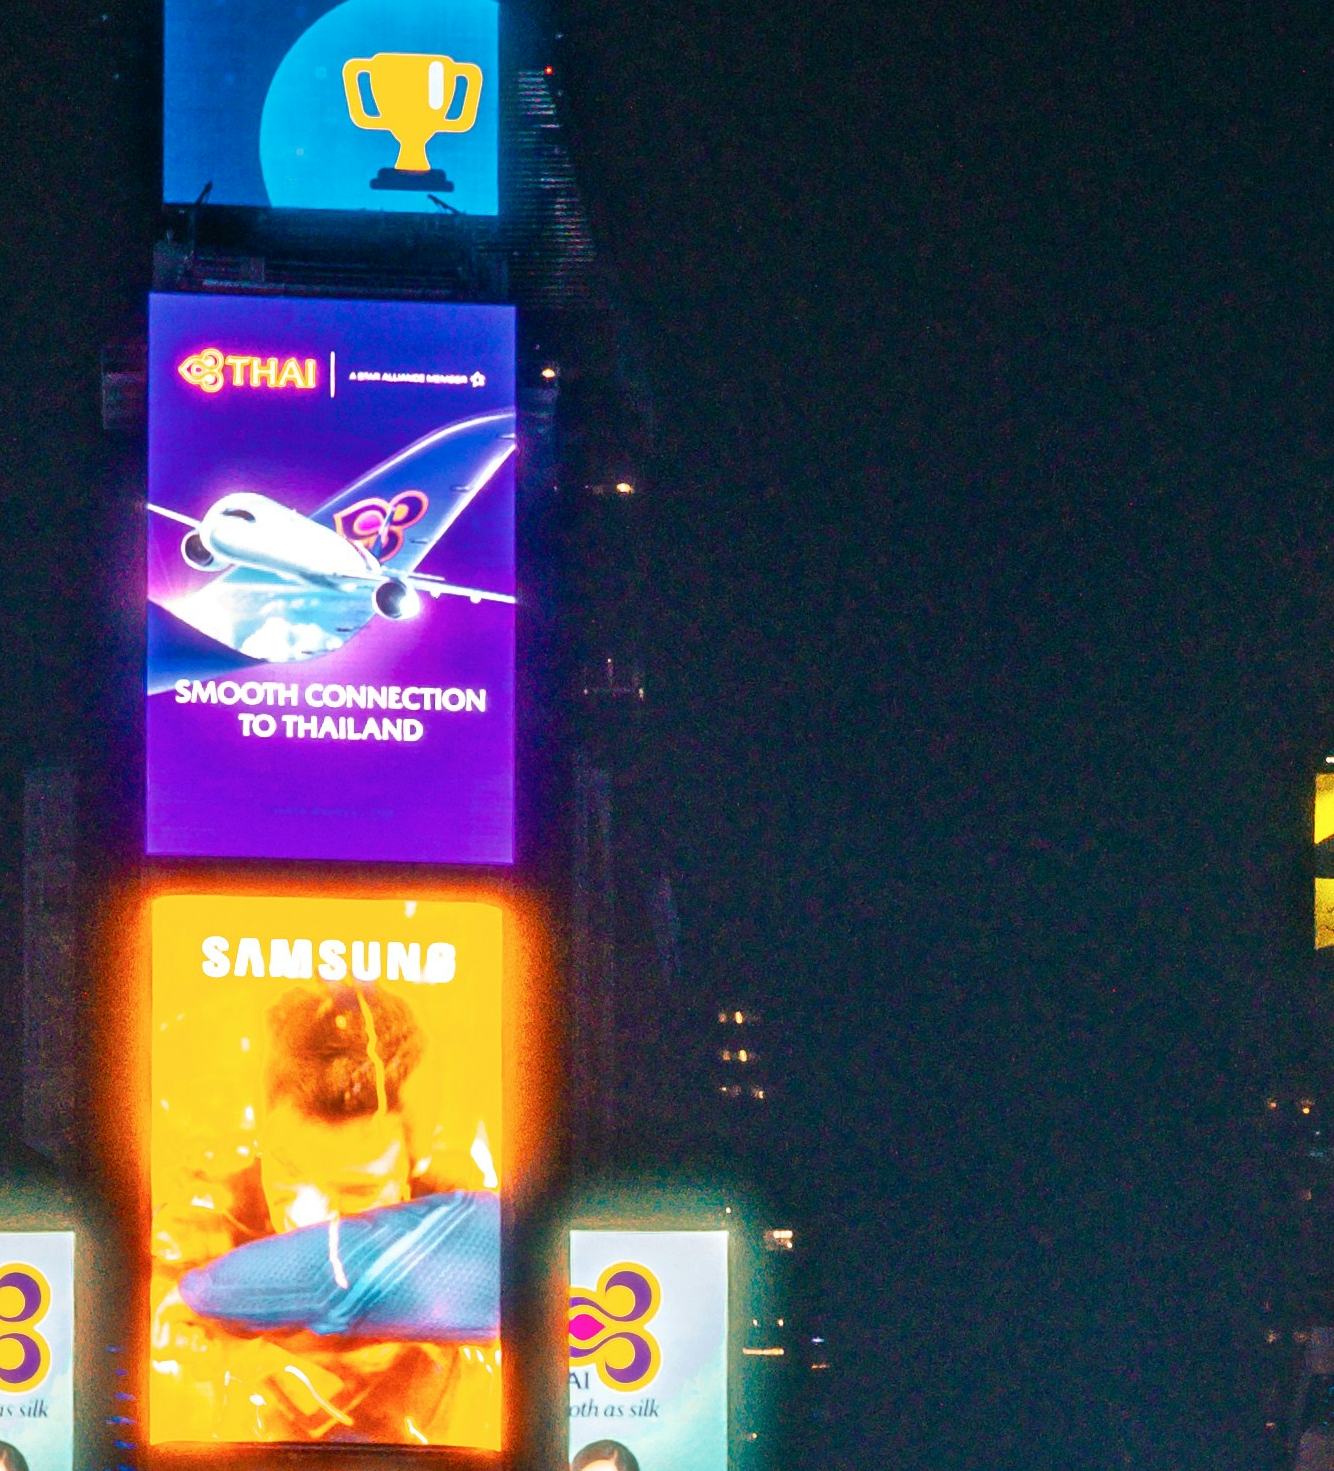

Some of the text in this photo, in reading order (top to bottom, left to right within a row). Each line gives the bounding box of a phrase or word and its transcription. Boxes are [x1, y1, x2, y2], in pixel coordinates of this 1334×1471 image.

[224, 355, 316, 389] THAI
[174, 679, 487, 713] SMOOTH CONNECTION
[238, 713, 424, 742] TO THAILAND
[201, 936, 456, 983] SAMSUNG
[568, 1371, 589, 1390] AI
[19, 1399, 49, 1419] silk
[603, 1404, 625, 1418] as
[629, 1397, 660, 1418] silk
